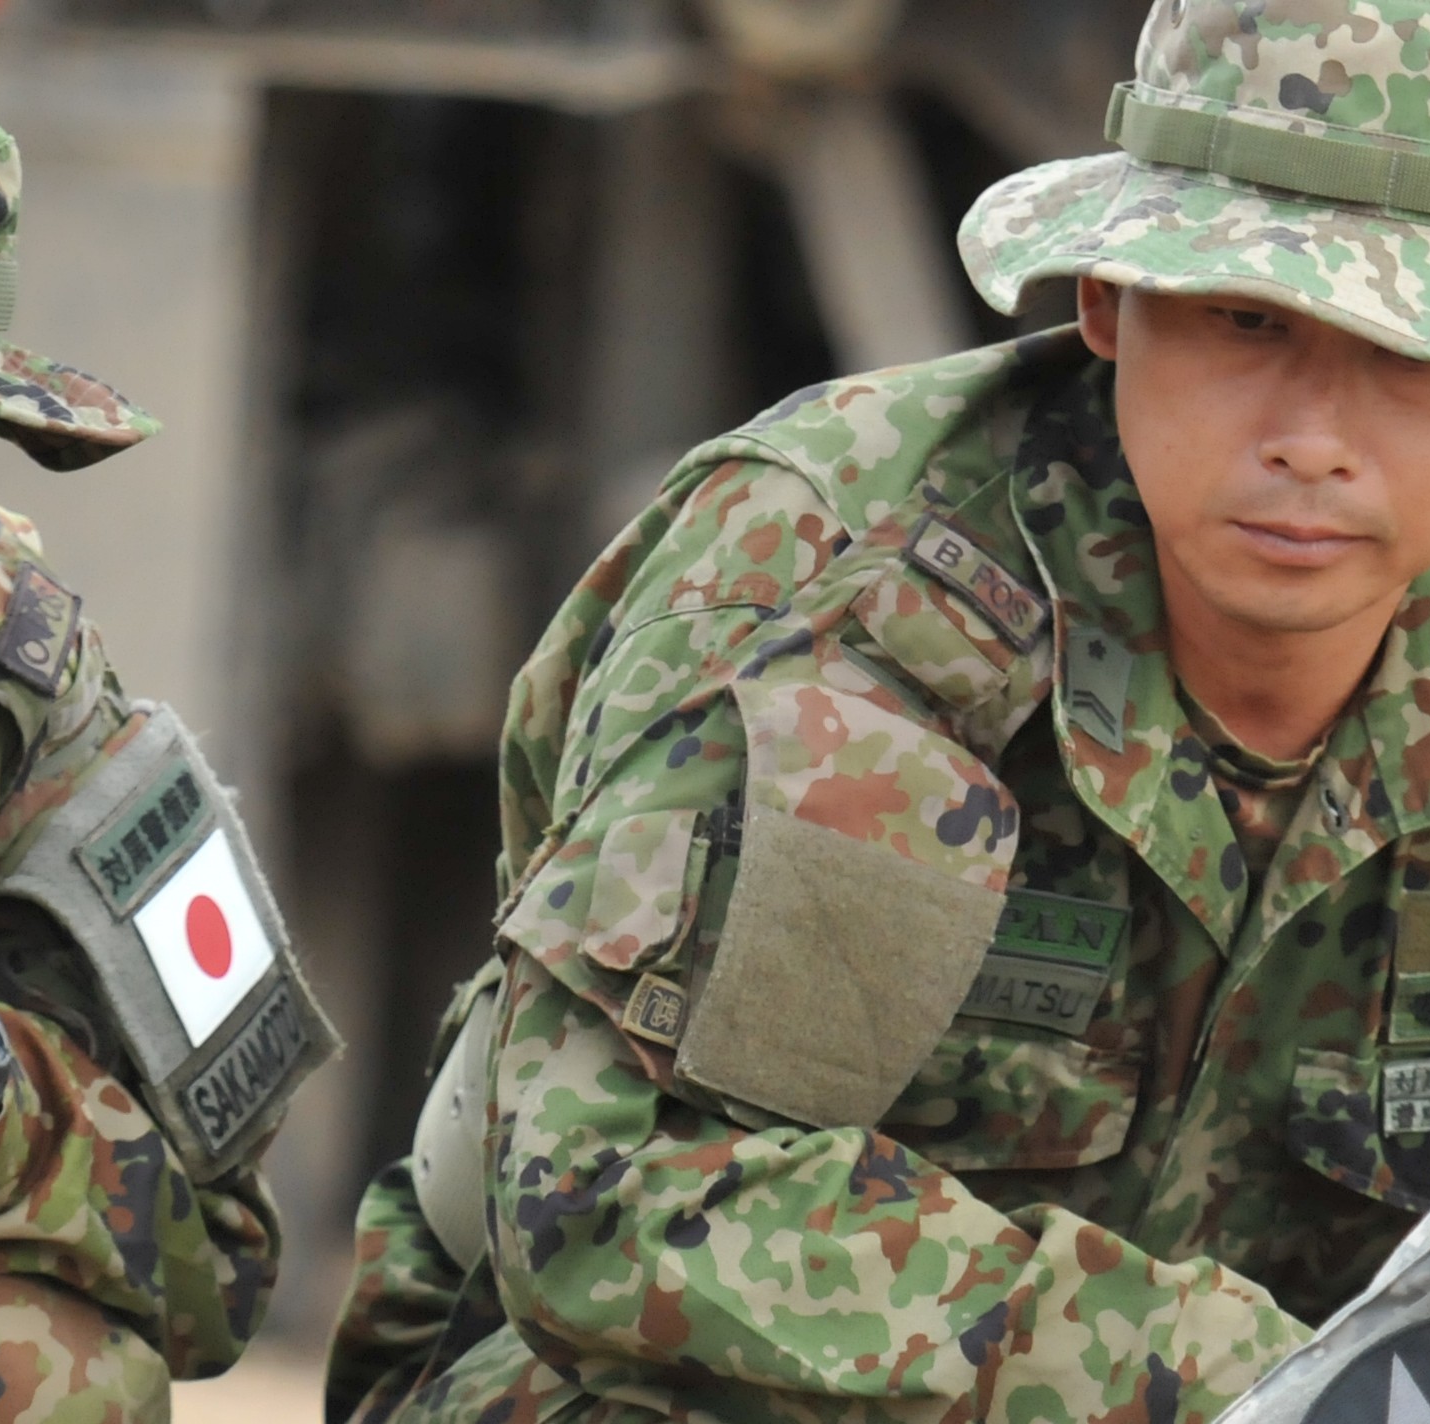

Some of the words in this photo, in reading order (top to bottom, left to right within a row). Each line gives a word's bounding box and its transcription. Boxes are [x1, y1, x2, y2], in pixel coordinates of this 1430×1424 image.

[933, 538, 964, 568] B
[969, 562, 1030, 628] POS
[995, 907, 1107, 951] PAN
